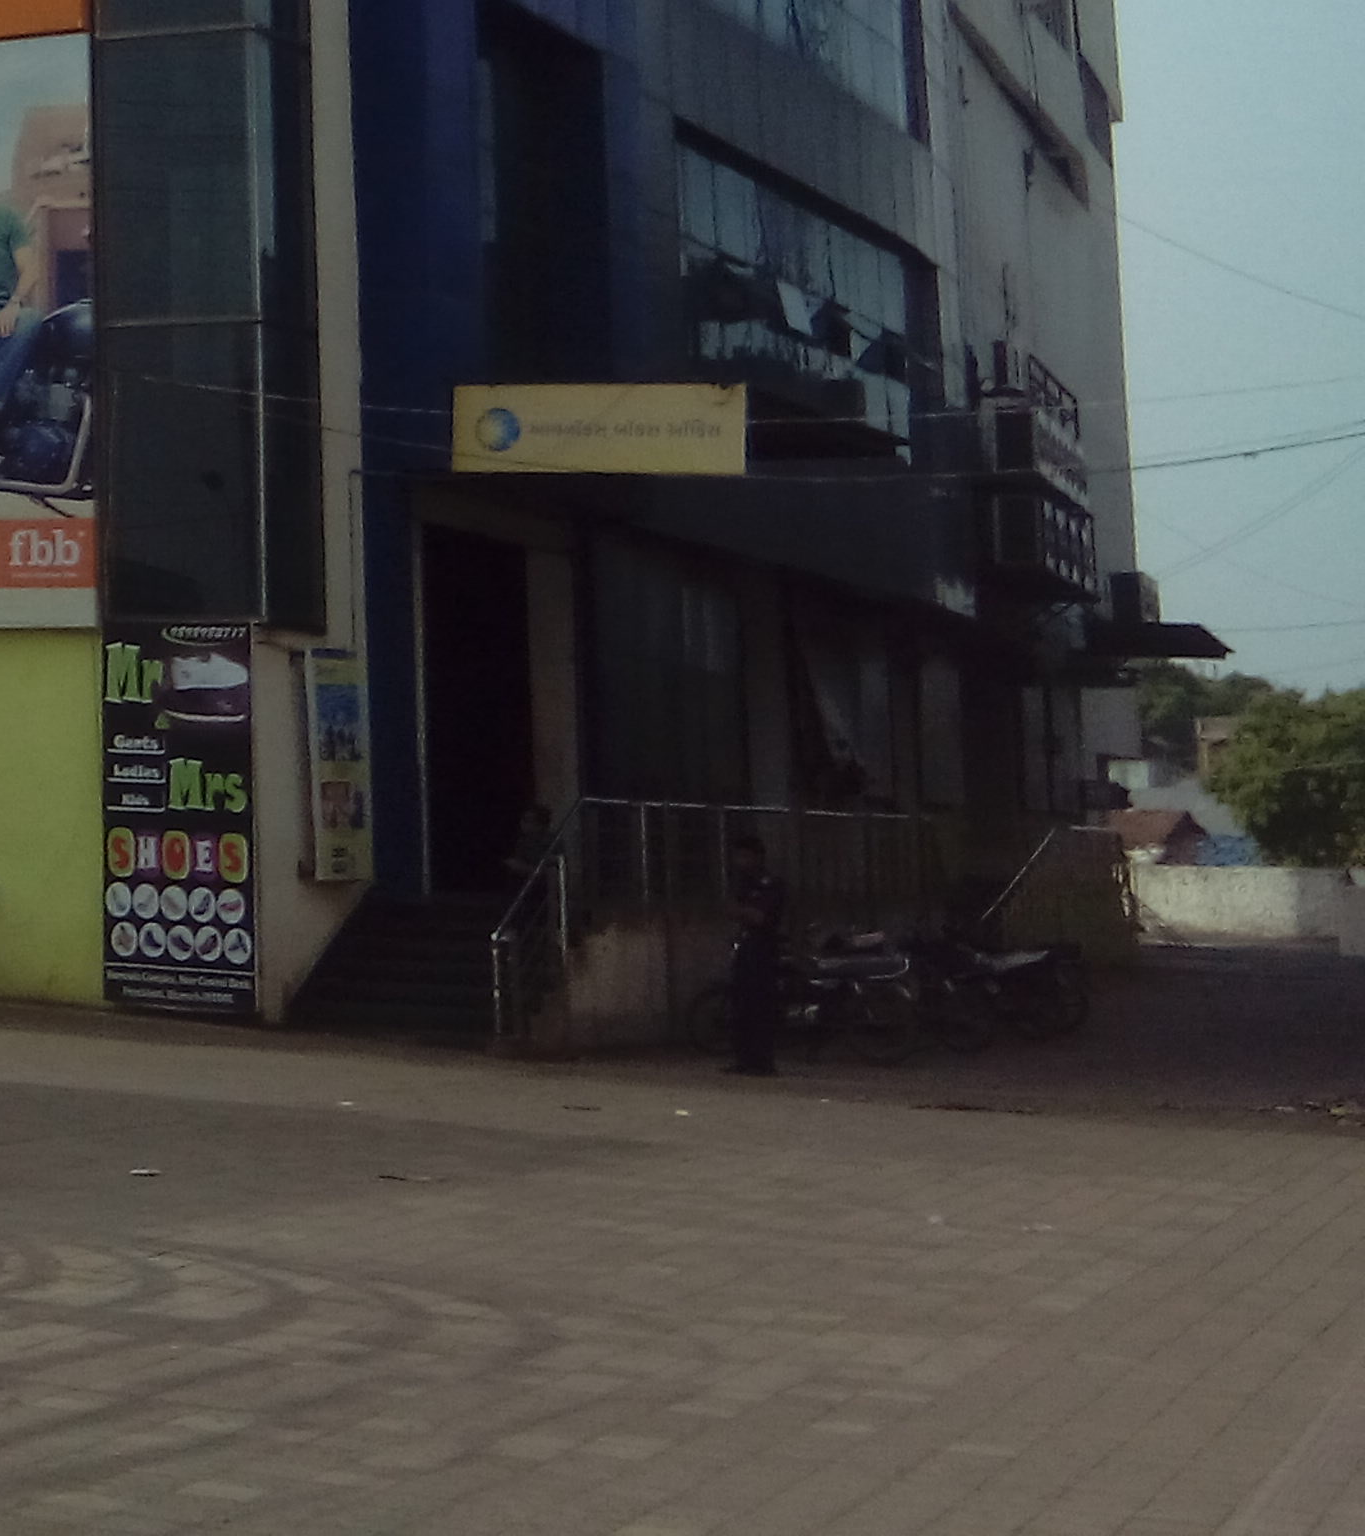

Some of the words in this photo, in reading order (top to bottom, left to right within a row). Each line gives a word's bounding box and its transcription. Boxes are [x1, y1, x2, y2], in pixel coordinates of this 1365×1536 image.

[9, 529, 81, 566] fbb
[104, 641, 165, 703] Mr
[168, 757, 248, 814] Mrs
[107, 827, 248, 883] SHOES
